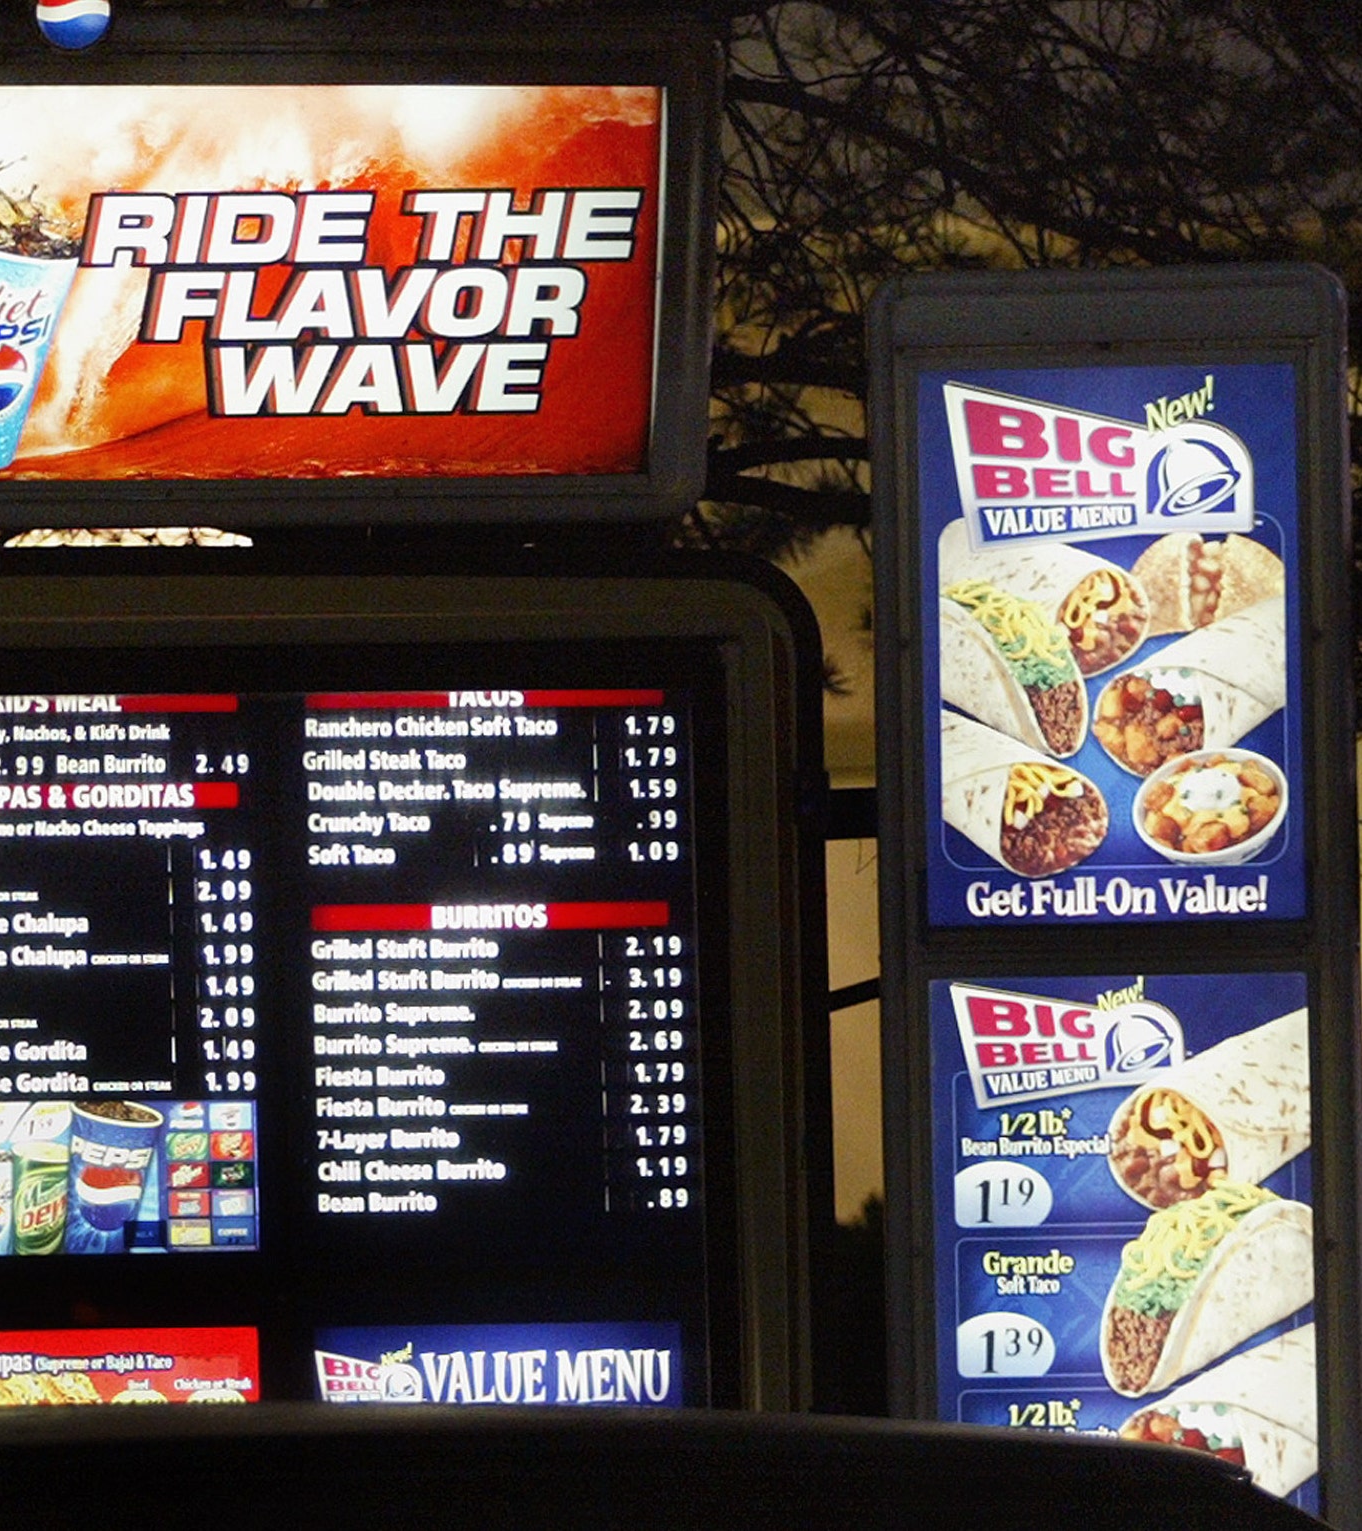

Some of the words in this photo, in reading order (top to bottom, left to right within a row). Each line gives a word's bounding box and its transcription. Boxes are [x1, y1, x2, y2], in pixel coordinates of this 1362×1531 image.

[77, 192, 375, 267] RIDE
[403, 188, 644, 261] THE
[139, 267, 587, 342] FLAVOR
[204, 341, 549, 416] WAVE
[1144, 374, 1215, 434] New!
[963, 399, 1136, 467] BIG
[972, 463, 1136, 499] BELL
[985, 507, 1068, 536] VALUE
[1071, 505, 1133, 528] MENU
[75, 727, 86, 742] &
[90, 725, 126, 742] Kid's
[129, 725, 170, 741] Drink
[305, 718, 392, 738] Ranchero
[396, 717, 468, 736] Chicken
[470, 717, 512, 736] Soft
[515, 717, 558, 736] Taco
[625, 715, 676, 736] 1.79
[56, 755, 100, 774] Bean
[103, 753, 166, 774] Burrito
[195, 754, 250, 773] 2.49
[303, 750, 366, 771] Grilled
[369, 750, 422, 770] Steak
[426, 750, 466, 770] Taco
[625, 747, 677, 767] 1.79
[48, 786, 67, 808] &
[73, 784, 195, 809] GORDITAS
[308, 813, 384, 836] Crunchy
[387, 813, 431, 832] Taco
[636, 811, 678, 830] .99
[199, 850, 251, 870] 1.49
[308, 845, 350, 866] Soft
[353, 845, 396, 864] Taco
[628, 842, 679, 862] 1.09
[966, 881, 1027, 917] Get
[1030, 876, 1156, 916] Full-On
[1159, 873, 1268, 914] Value!
[12, 913, 89, 937] Chalupa
[200, 913, 253, 933] 1.49
[430, 905, 548, 929] BURRITOS
[205, 976, 254, 996] 1.49
[1096, 975, 1145, 1012] New!
[966, 996, 1096, 1038] BIG
[14, 1040, 87, 1061] Gordita
[203, 1040, 255, 1060] 1.49
[976, 1042, 1098, 1068] BELL
[315, 1067, 373, 1087] Fiesta
[376, 1066, 445, 1086] Burrito
[634, 1063, 685, 1083] 1.79
[986, 1072, 1048, 1096] VALUE
[1051, 1067, 1097, 1087] MENU
[1000, 1113, 1037, 1136] 1/2
[318, 1130, 388, 1154] 7-Layer
[390, 1129, 460, 1149] Burrito
[636, 1126, 686, 1145] 1.79
[961, 1137, 997, 1157] Bean
[1000, 1137, 1052, 1156] Burrito
[1054, 1135, 1110, 1160] Especial
[318, 1192, 365, 1213] Bean
[368, 1192, 438, 1212] Burrito
[648, 1189, 689, 1209] .89
[983, 1250, 1074, 1276] Grande
[997, 1276, 1025, 1295] Soft
[1027, 1275, 1060, 1294] Taco
[146, 1355, 172, 1369] Taco
[323, 1358, 381, 1380] BIG
[326, 1380, 379, 1391] BELL
[421, 1350, 549, 1403] VALUE
[555, 1349, 671, 1402] MENU
[1008, 1404, 1045, 1427] 1/2
